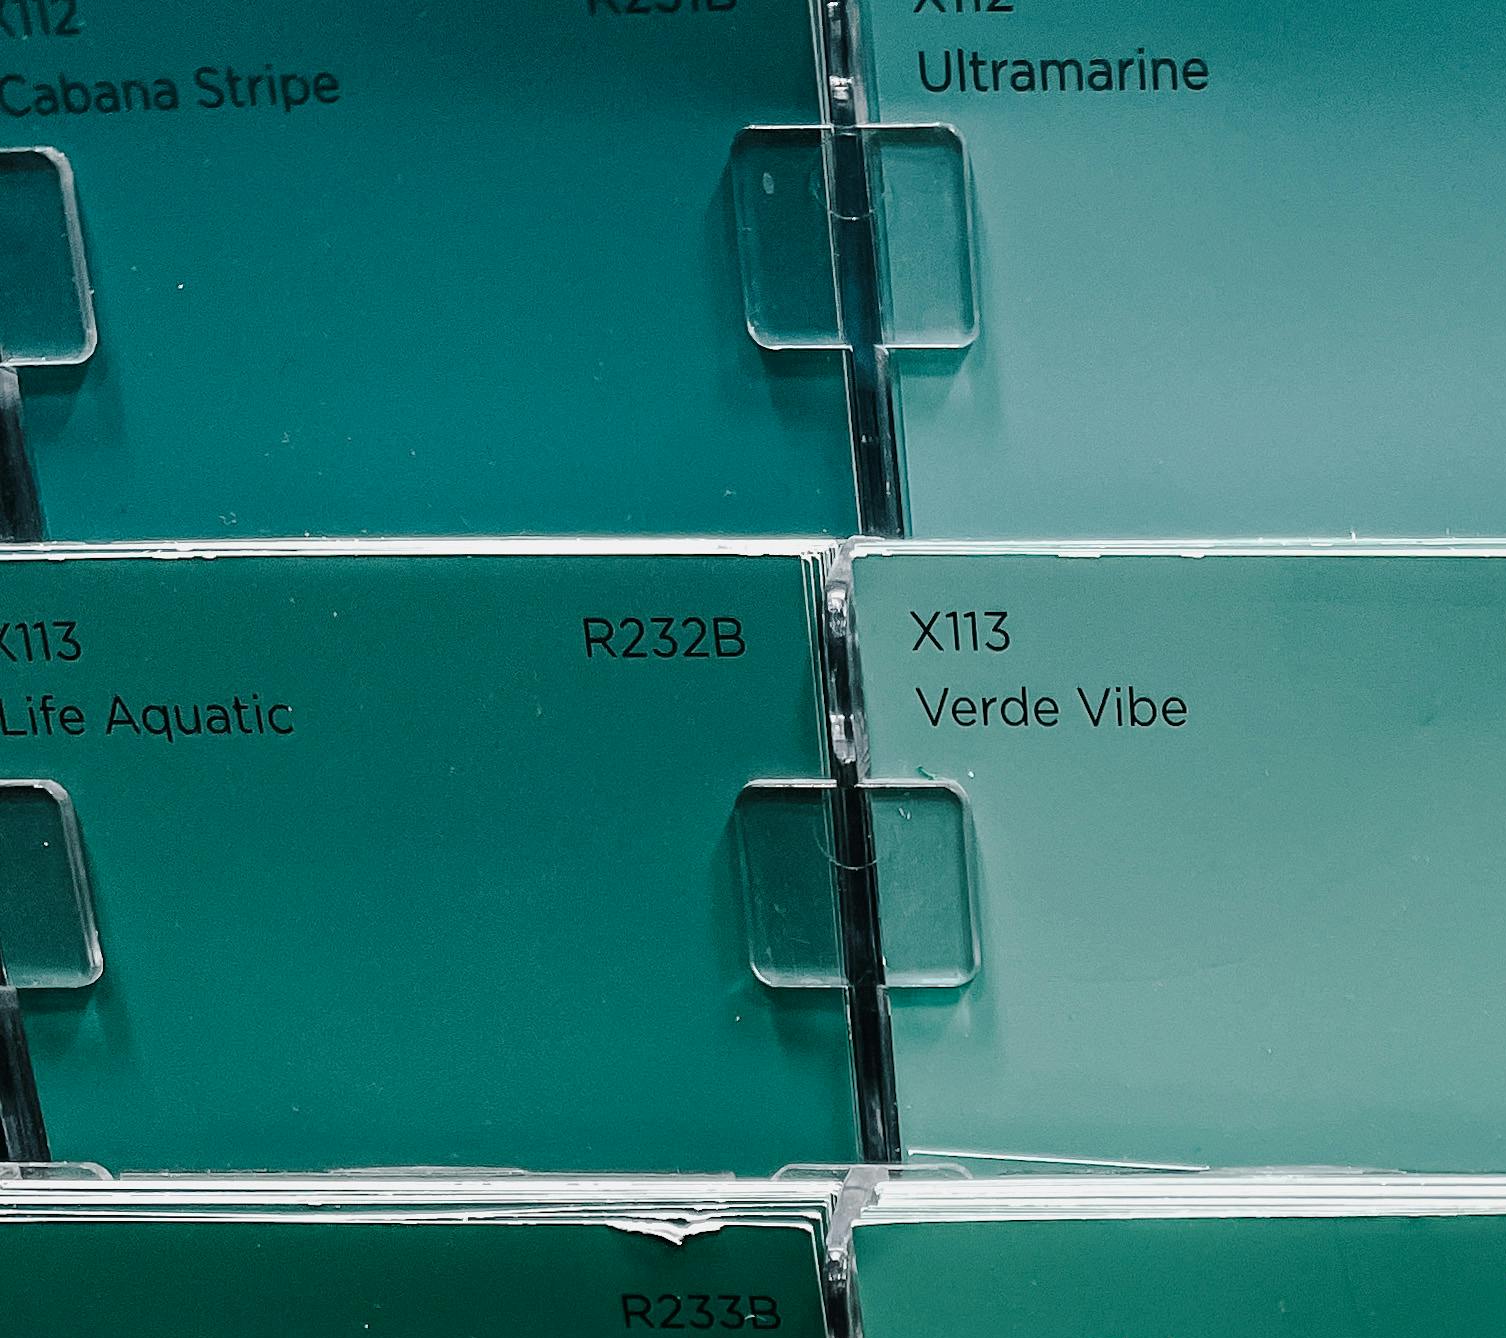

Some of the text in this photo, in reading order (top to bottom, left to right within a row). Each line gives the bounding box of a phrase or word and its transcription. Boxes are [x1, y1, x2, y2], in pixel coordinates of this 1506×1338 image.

[0, 64, 340, 118] Cabana Stripe
[918, 47, 1209, 93] Ultramarine
[583, 616, 745, 658] R232B
[910, 611, 1010, 652] X113
[0, 695, 294, 743] Life Aquatic
[915, 686, 1187, 727] Verde Vibe
[621, 1293, 781, 1330] R233B
